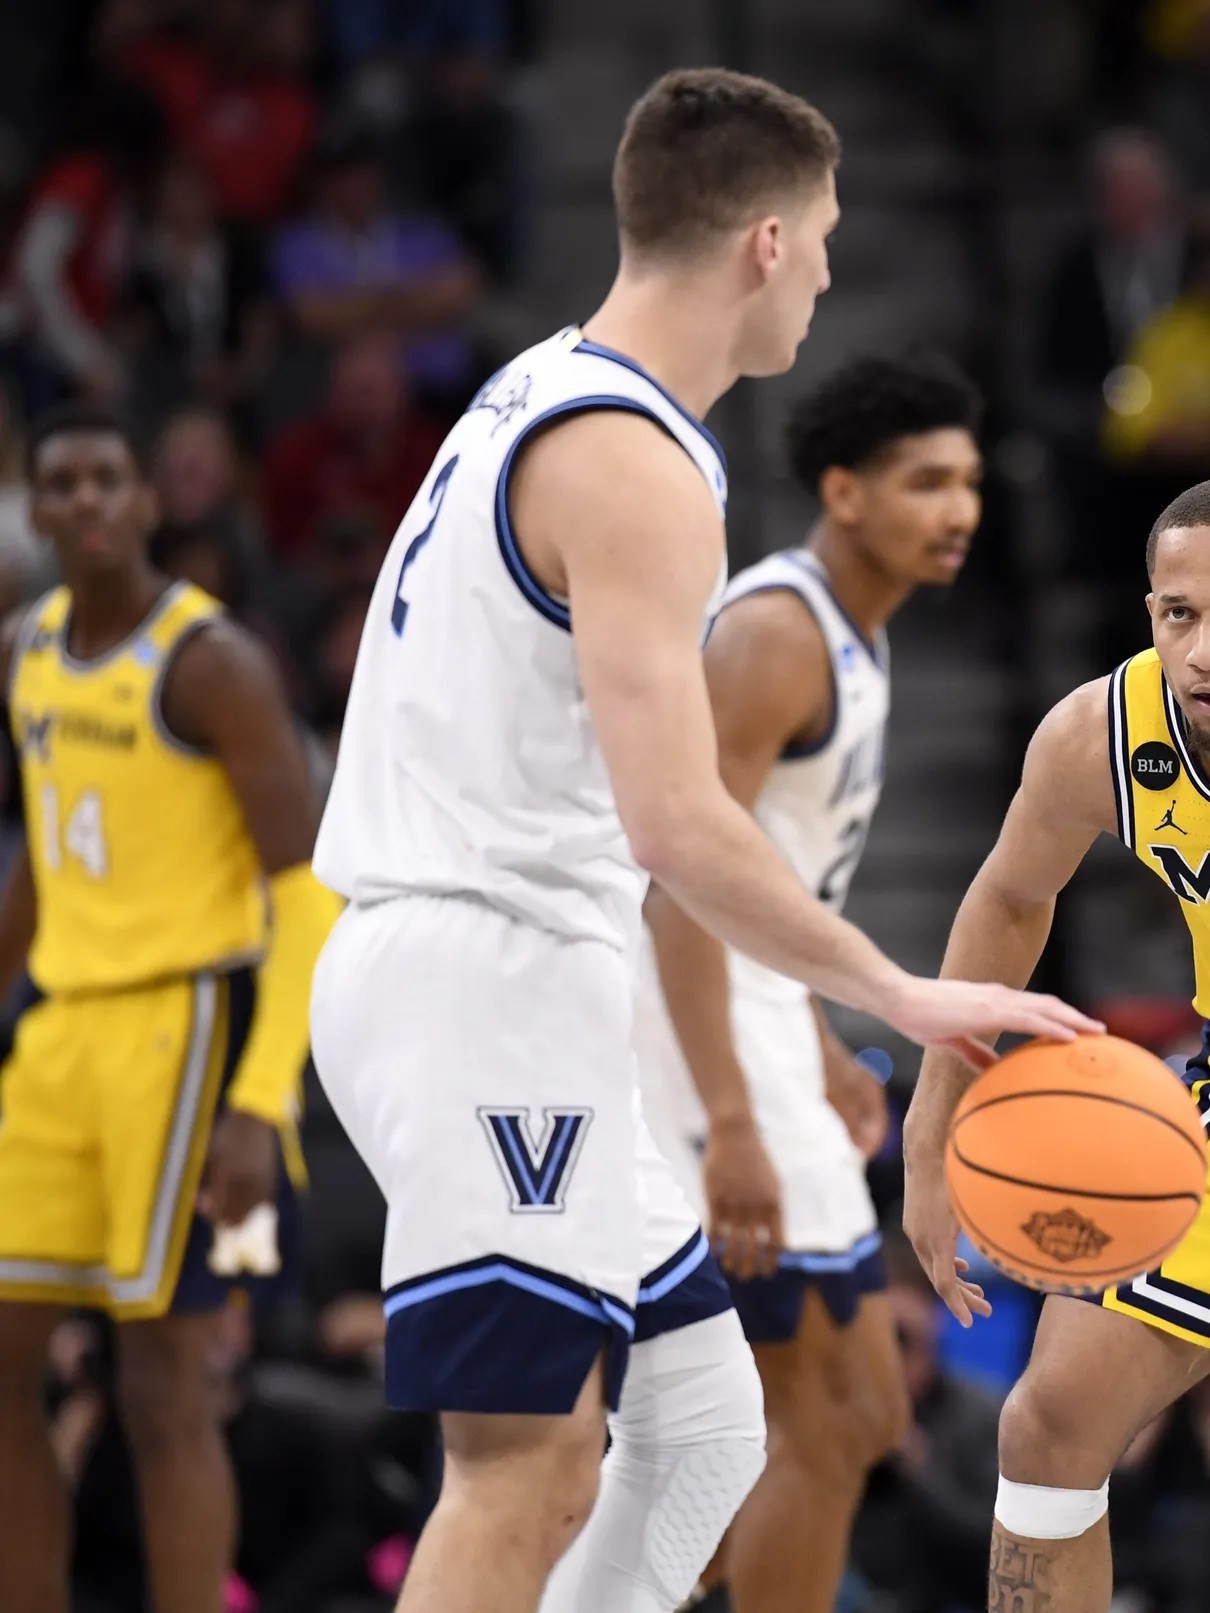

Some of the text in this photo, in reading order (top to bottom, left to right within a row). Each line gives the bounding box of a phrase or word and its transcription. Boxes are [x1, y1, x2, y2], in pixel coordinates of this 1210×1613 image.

[391, 454, 460, 638] 2
[1136, 758, 1174, 775] BLM
[42, 782, 109, 880] 14
[477, 1105, 594, 1214] V
